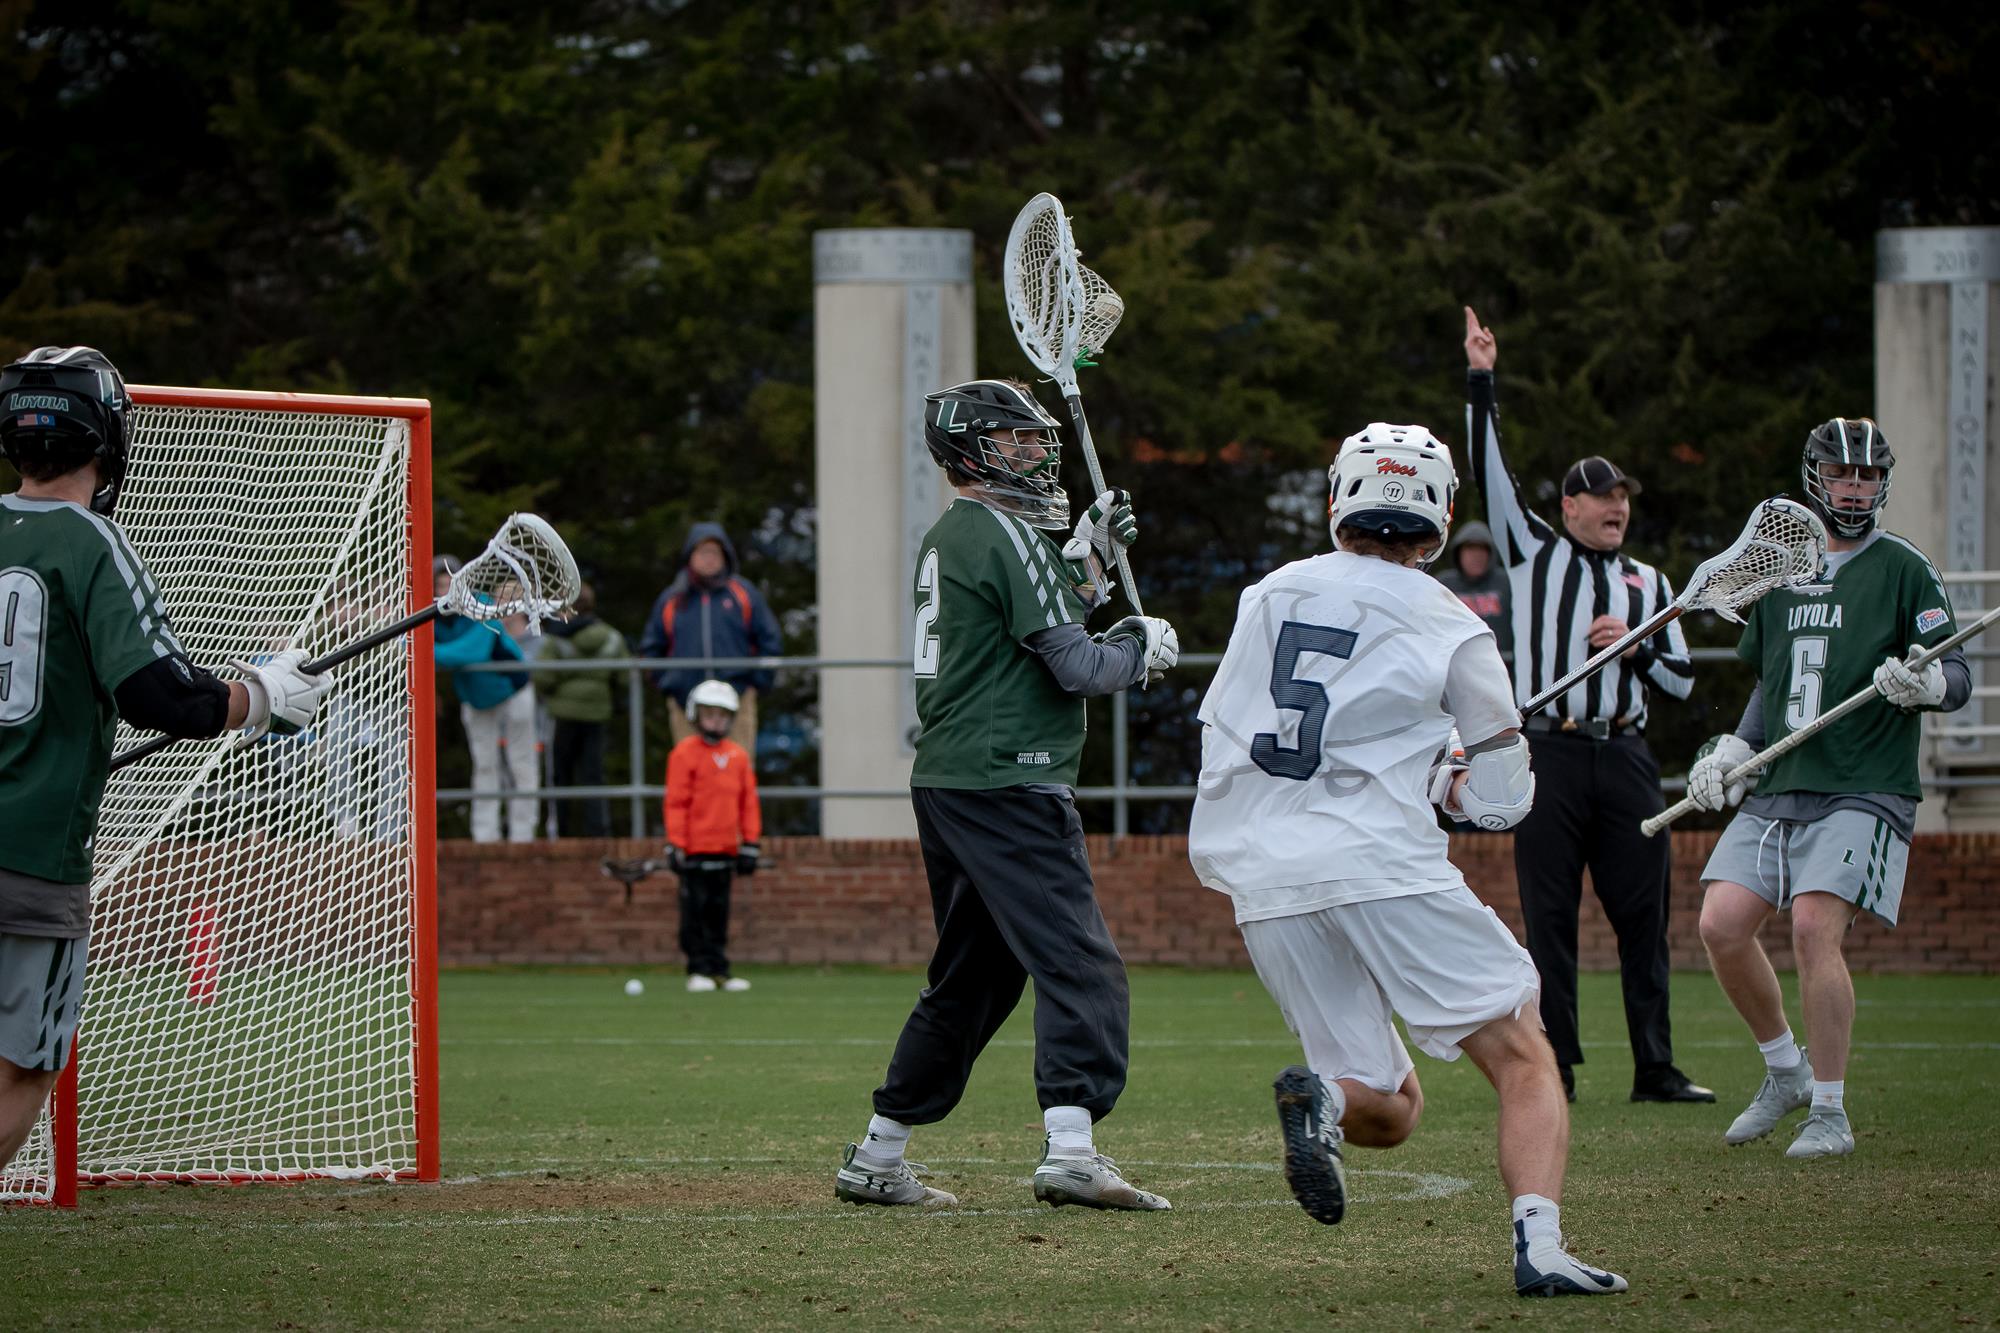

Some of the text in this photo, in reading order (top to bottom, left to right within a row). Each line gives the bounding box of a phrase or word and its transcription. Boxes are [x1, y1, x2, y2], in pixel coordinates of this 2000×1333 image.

[10, 392, 69, 412] LOYOLA
[1956, 328, 1979, 501] NATIONAL
[1376, 457, 1418, 477] Hoos
[0, 566, 49, 726] 9
[914, 547, 940, 679] 2
[1787, 603, 1842, 631] LOYOLA
[1250, 620, 1360, 781] 5
[1785, 635, 1829, 732] 5
